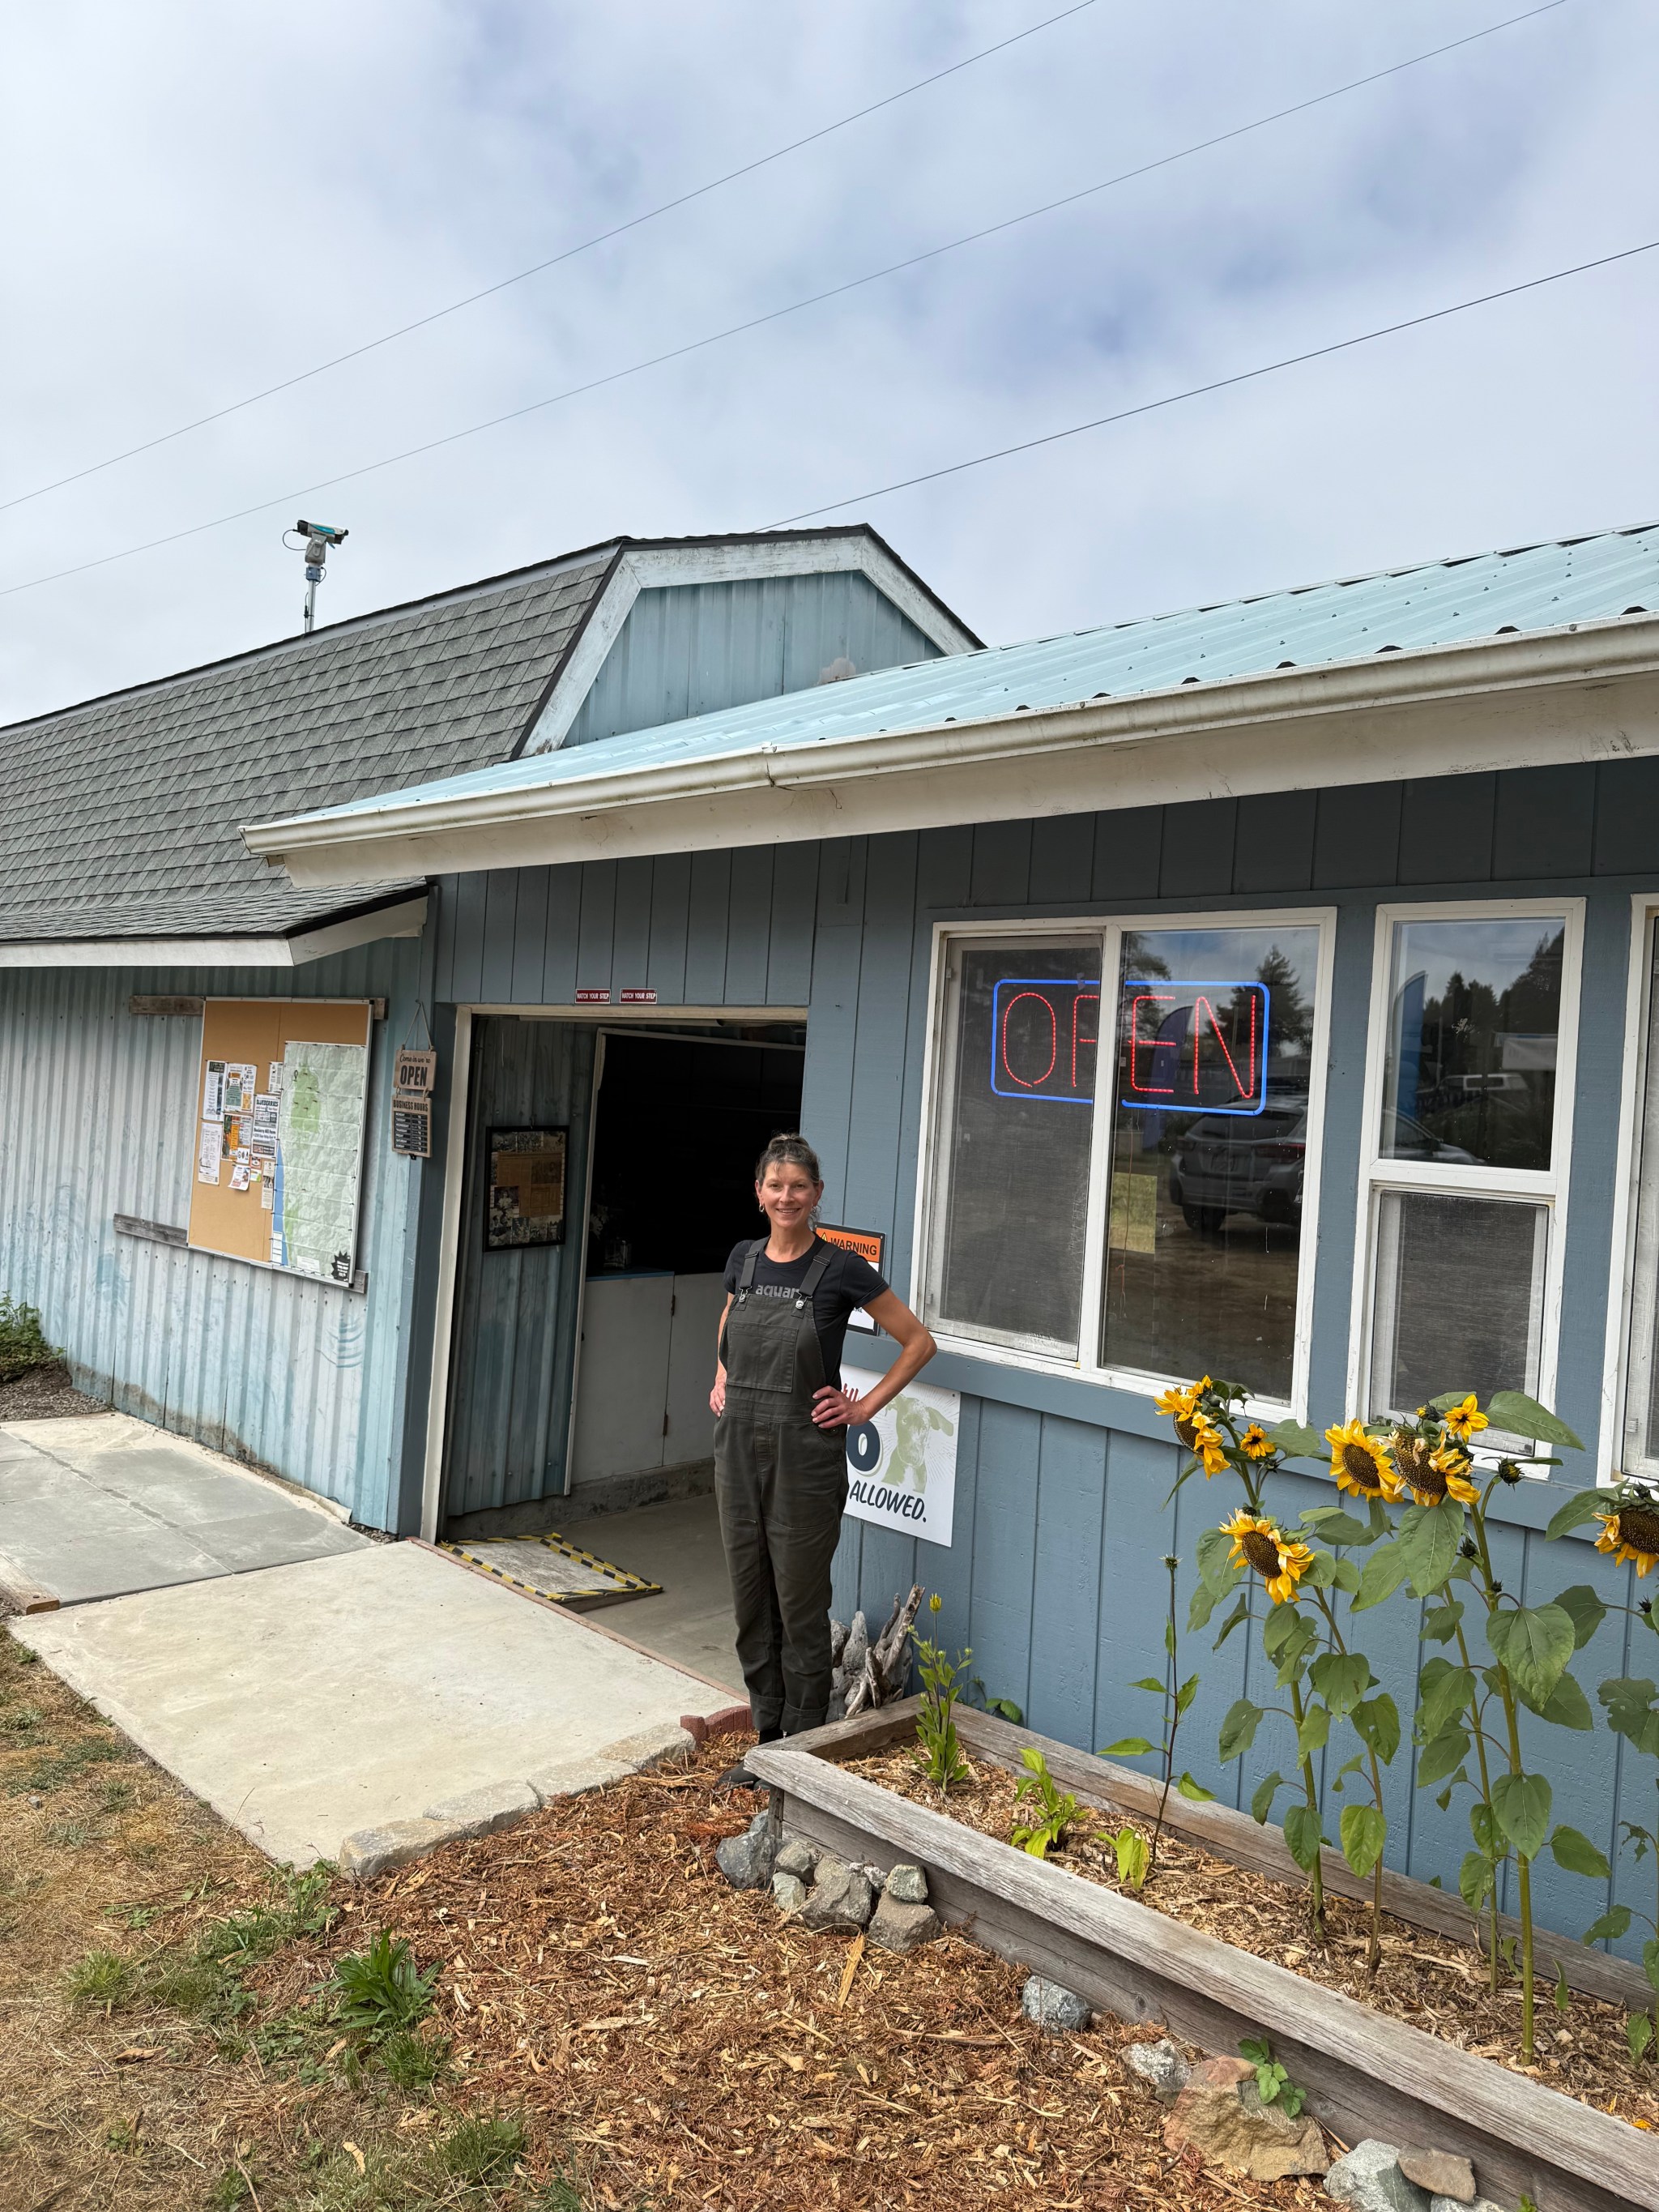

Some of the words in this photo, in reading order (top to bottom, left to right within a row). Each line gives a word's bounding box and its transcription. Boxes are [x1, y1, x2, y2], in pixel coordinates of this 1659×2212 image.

[1003, 992, 1256, 1099] OPEN
[399, 1053, 412, 1062] Come
[400, 1065, 428, 1087] OPEN
[393, 1100, 413, 1110] BUSINESS
[414, 1102, 429, 1112] HOURS
[830, 1237, 877, 1256] WARNING
[846, 1420, 881, 1472] O
[850, 1480, 927, 1523] ALLOWED.
